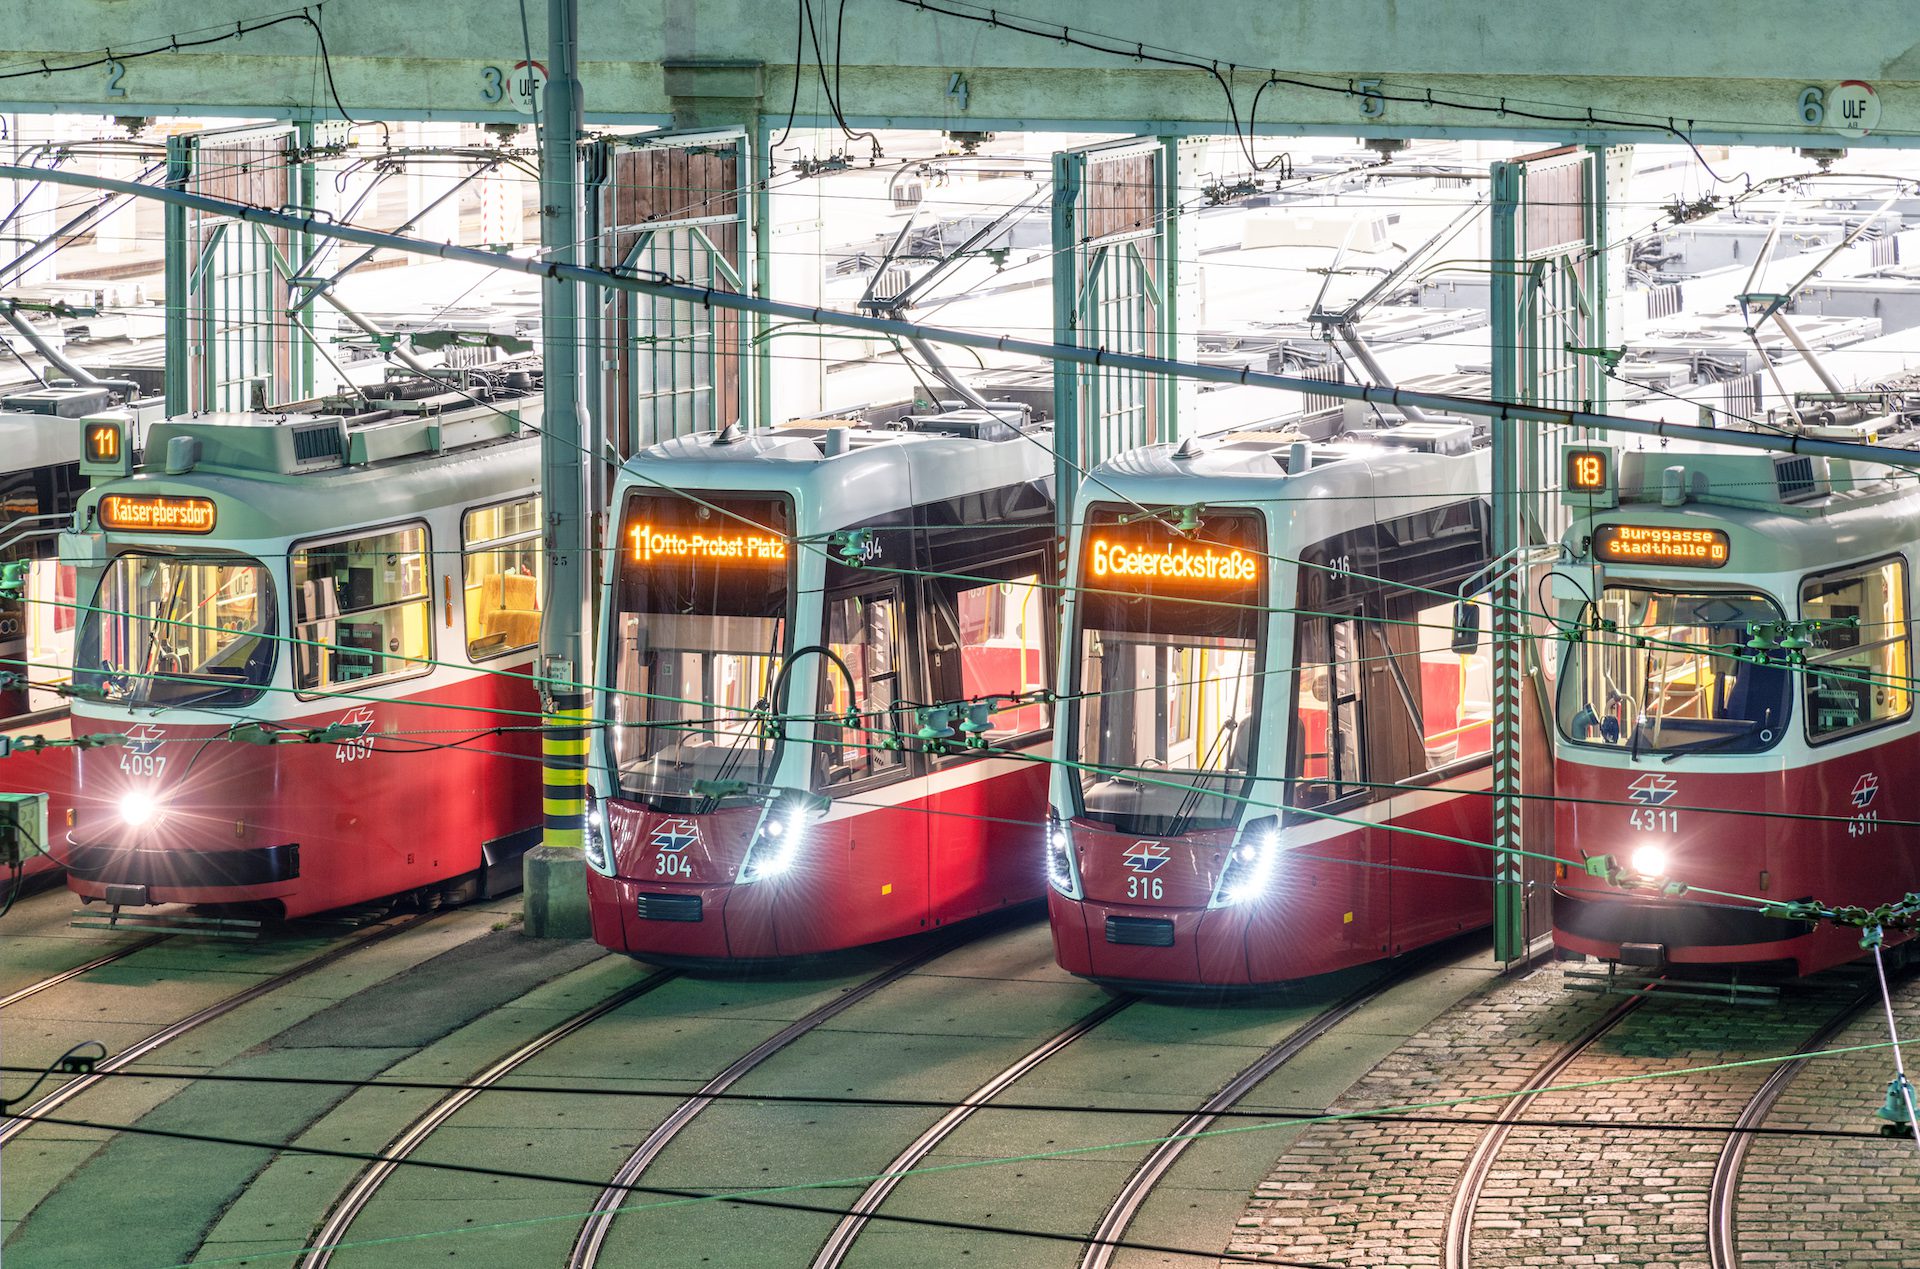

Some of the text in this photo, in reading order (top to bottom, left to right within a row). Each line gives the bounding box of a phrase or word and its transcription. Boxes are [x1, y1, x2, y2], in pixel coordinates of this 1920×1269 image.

[105, 61, 125, 97] 2
[480, 66, 503, 104] 3
[945, 72, 969, 110] 4
[1359, 79, 1385, 118] 5
[1798, 86, 1824, 126] 6
[1843, 100, 1866, 118] ULF
[94, 428, 115, 456] 11
[1576, 457, 1599, 485] 18
[631, 524, 650, 560] 11
[1610, 540, 1706, 556] Stadthalle
[1620, 527, 1713, 543] Burggasse
[1093, 540, 1256, 580] 6 Geiereckstraße
[1330, 555, 1350, 580] 316
[335, 737, 375, 763] 4097
[119, 754, 167, 777] 4097
[1629, 809, 1678, 833] 4311
[1848, 810, 1877, 838] 4311
[655, 853, 692, 878] 304
[1127, 876, 1163, 900] 316
